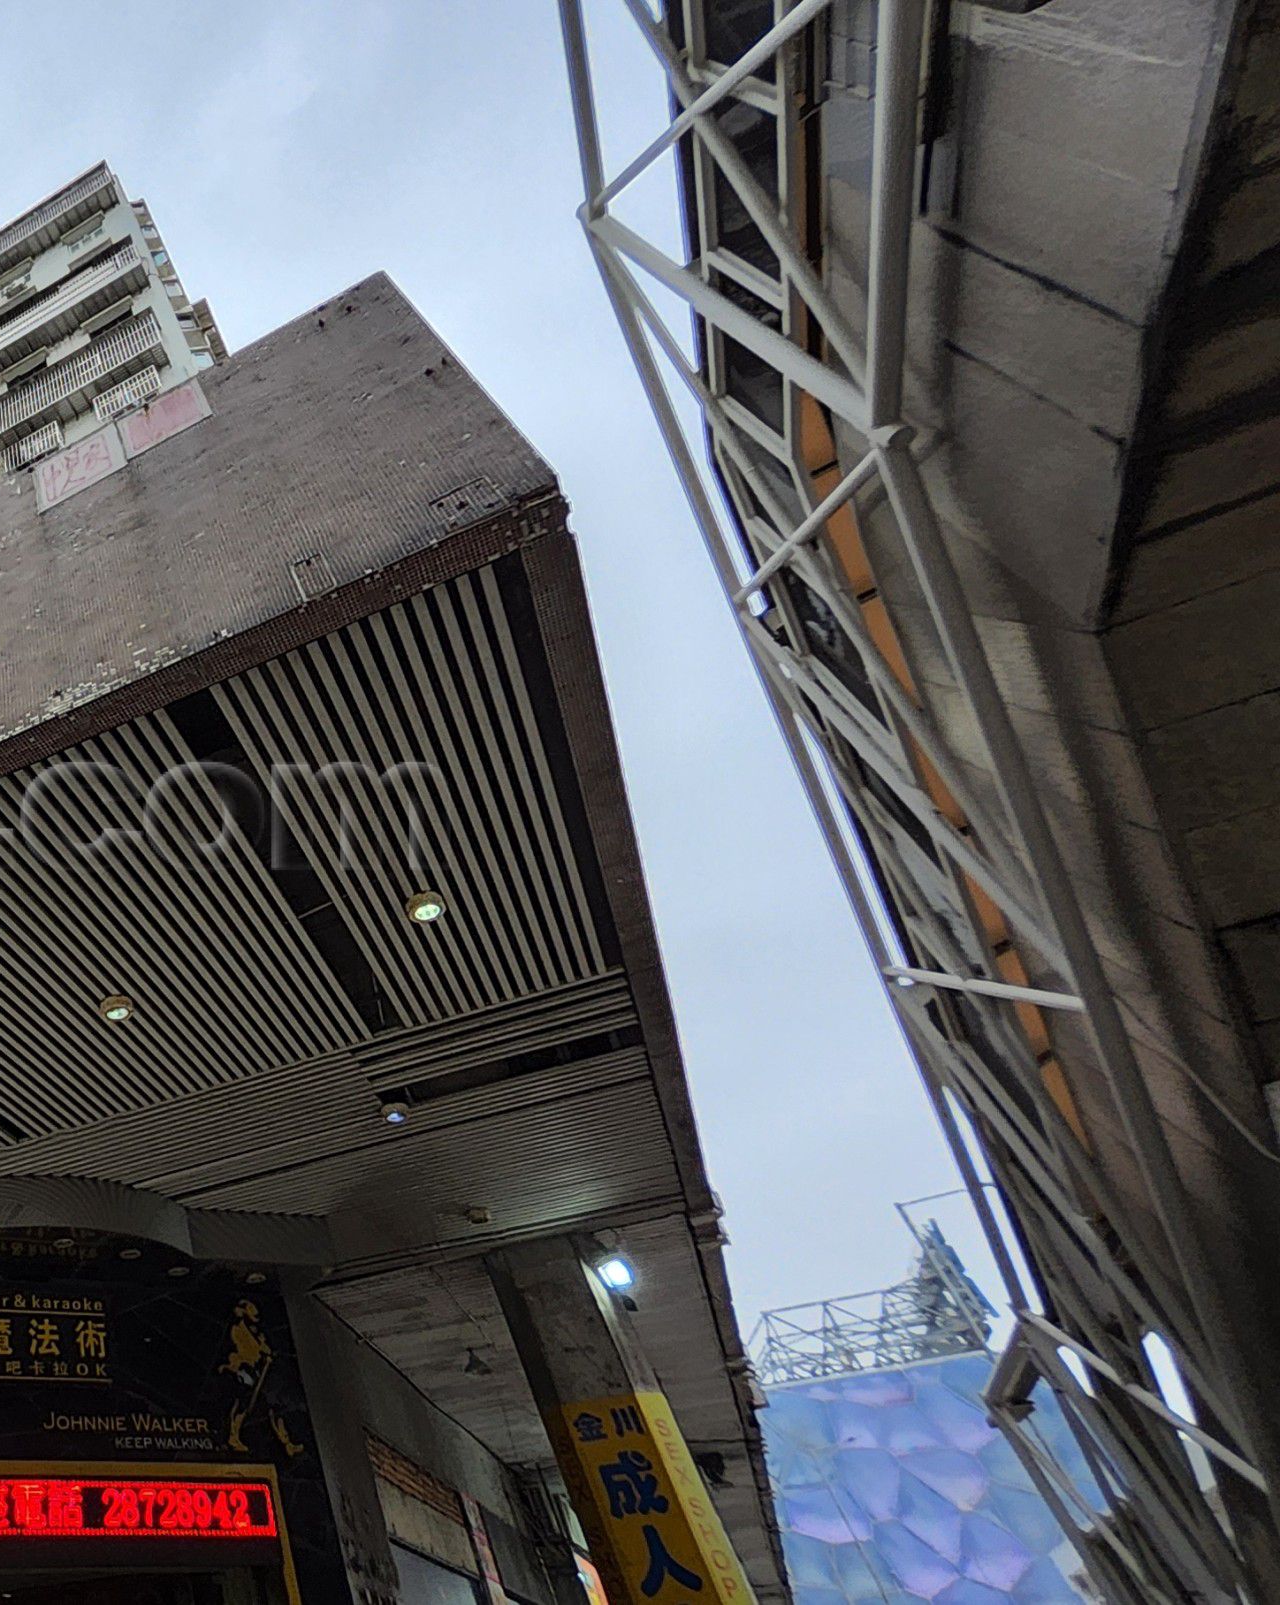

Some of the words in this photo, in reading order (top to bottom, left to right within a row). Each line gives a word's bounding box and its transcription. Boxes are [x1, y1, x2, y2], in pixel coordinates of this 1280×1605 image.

[13, 1293, 27, 1309] &
[31, 1294, 104, 1312] karaoke
[42, 1410, 127, 1432] JOHNNIE
[130, 1412, 210, 1434] WALKER
[573, 1405, 646, 1442] 金川
[114, 1435, 153, 1450] KEEP
[101, 1487, 251, 1529] 28728942
[599, 1450, 703, 1598] 成人
[654, 1418, 692, 1487] SEX
[687, 1496, 739, 1600] SHOP
